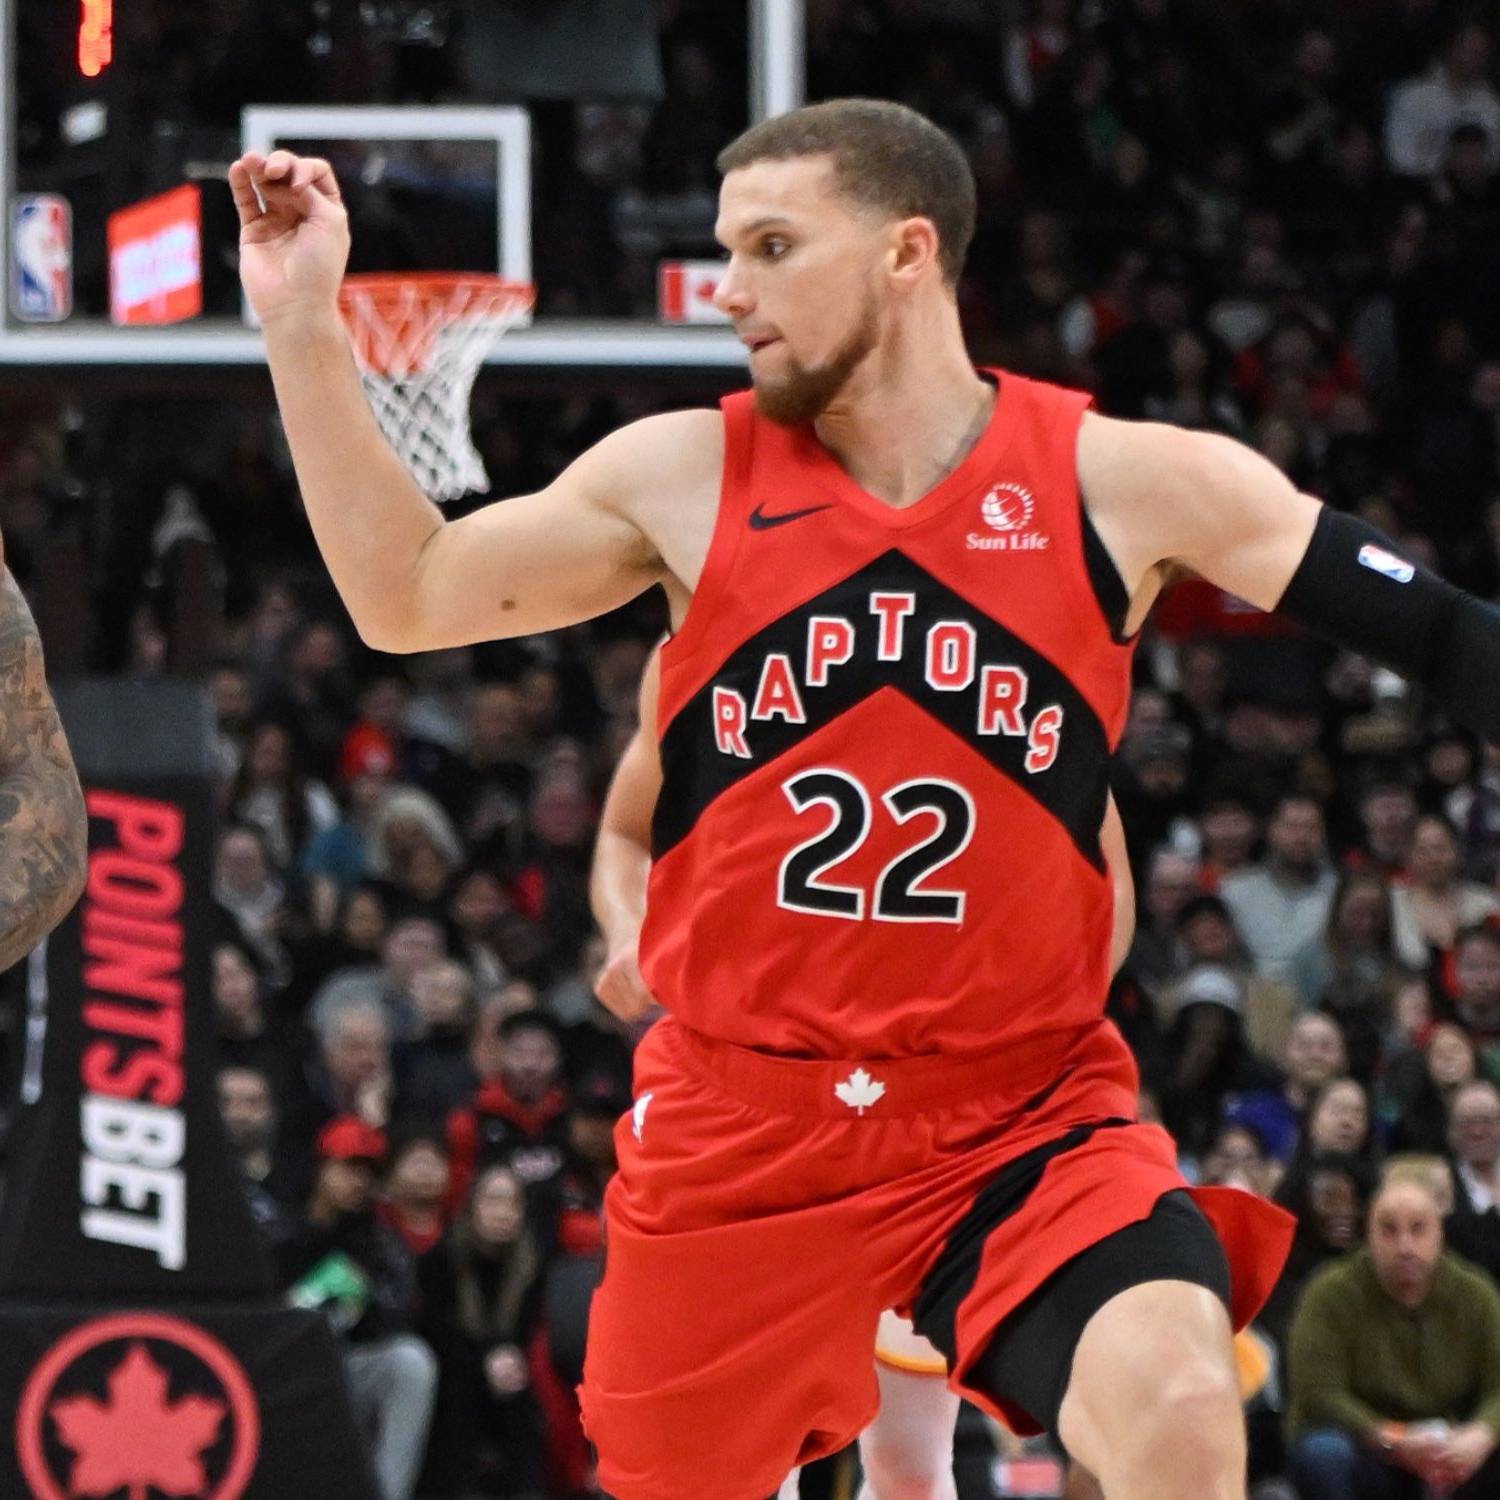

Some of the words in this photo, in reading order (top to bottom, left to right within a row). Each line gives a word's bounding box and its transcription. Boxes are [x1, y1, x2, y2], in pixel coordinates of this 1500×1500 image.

[965, 532, 1008, 551] Sun
[1010, 532, 1050, 551] Life
[712, 591, 1064, 775] RAPTORS
[776, 767, 978, 926] 22
[78, 787, 187, 1272] POINTSBET
